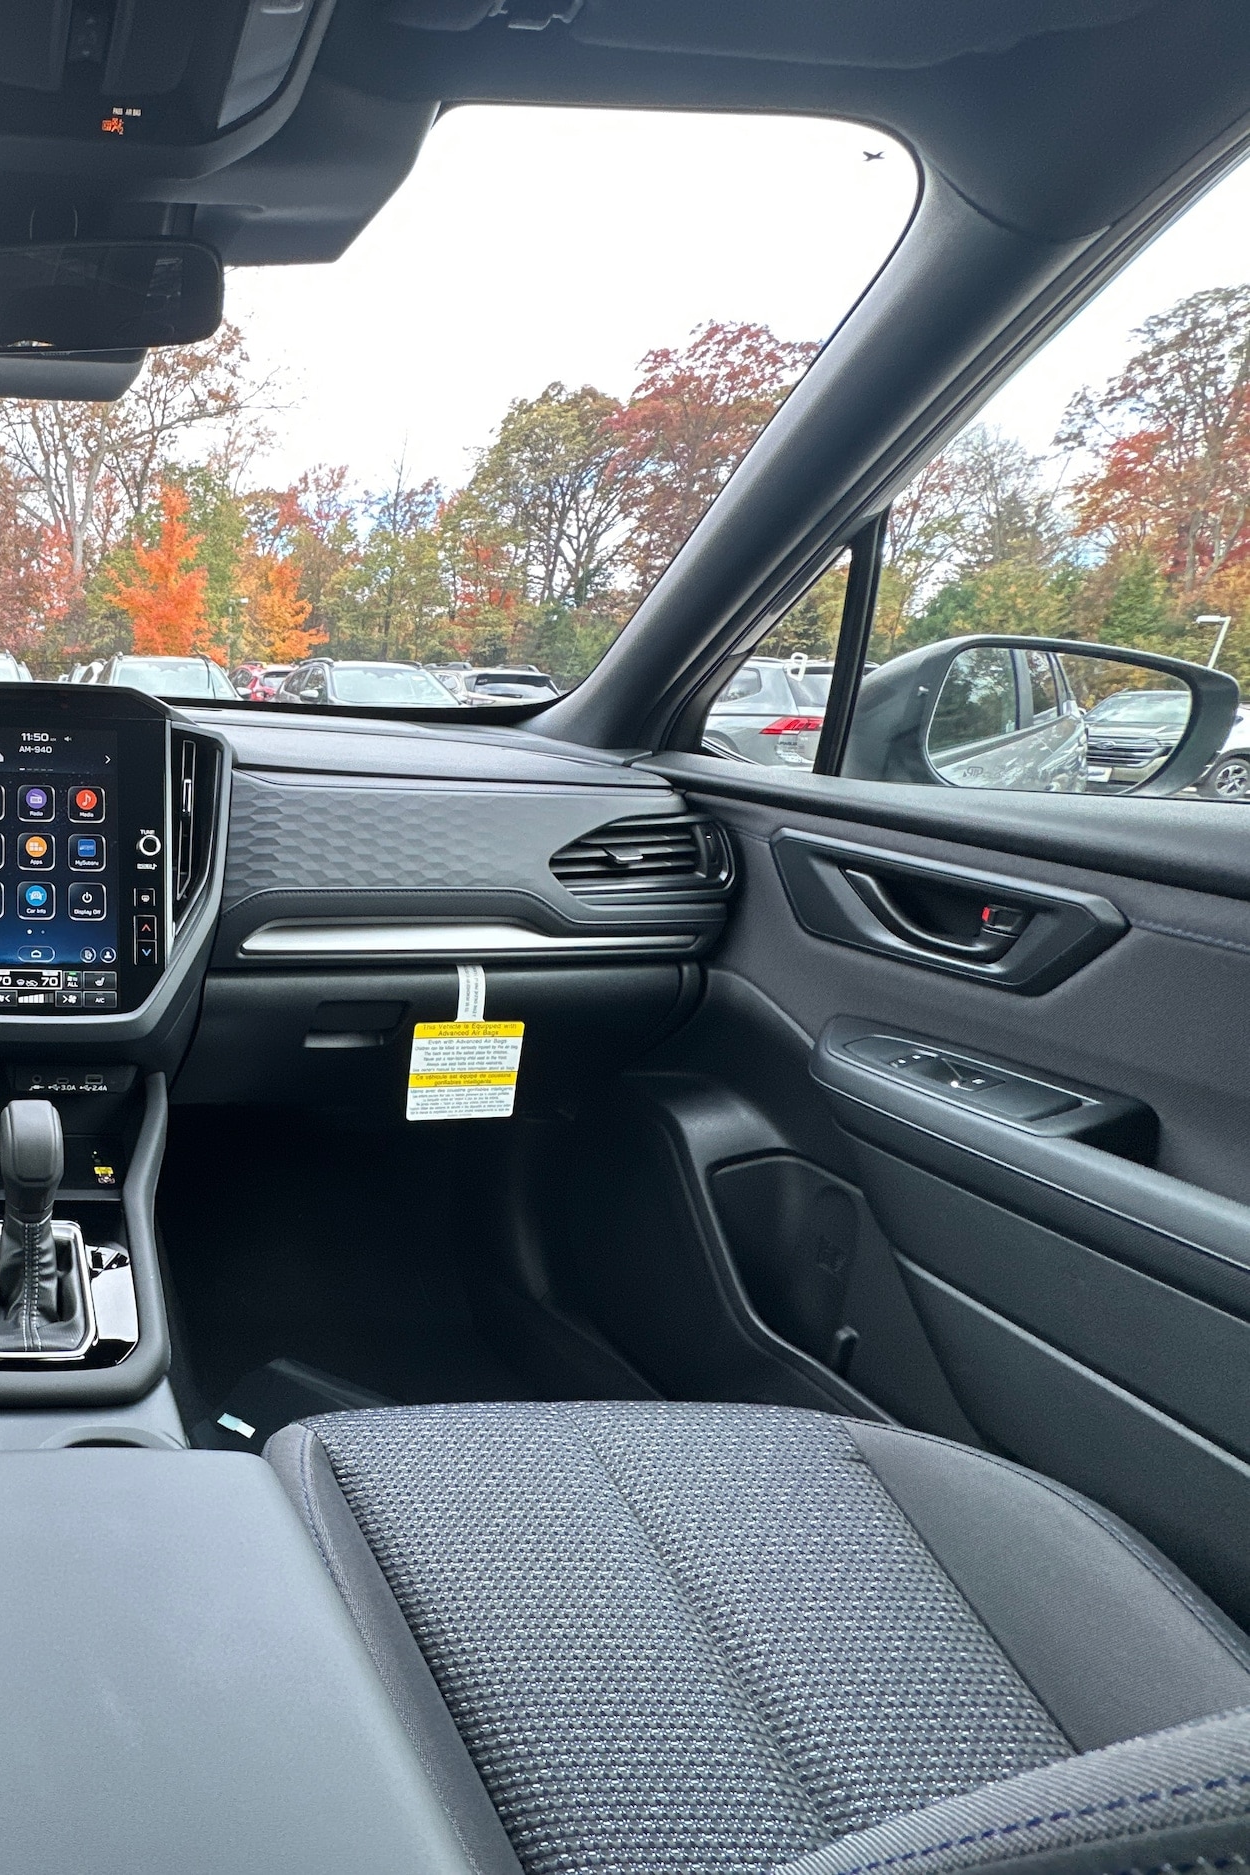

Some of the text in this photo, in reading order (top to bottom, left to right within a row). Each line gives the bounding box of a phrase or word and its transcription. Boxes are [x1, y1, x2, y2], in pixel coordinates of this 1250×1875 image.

[21, 733, 49, 742] 11:50
[18, 745, 53, 754] AM-940
[41, 976, 59, 986] 70
